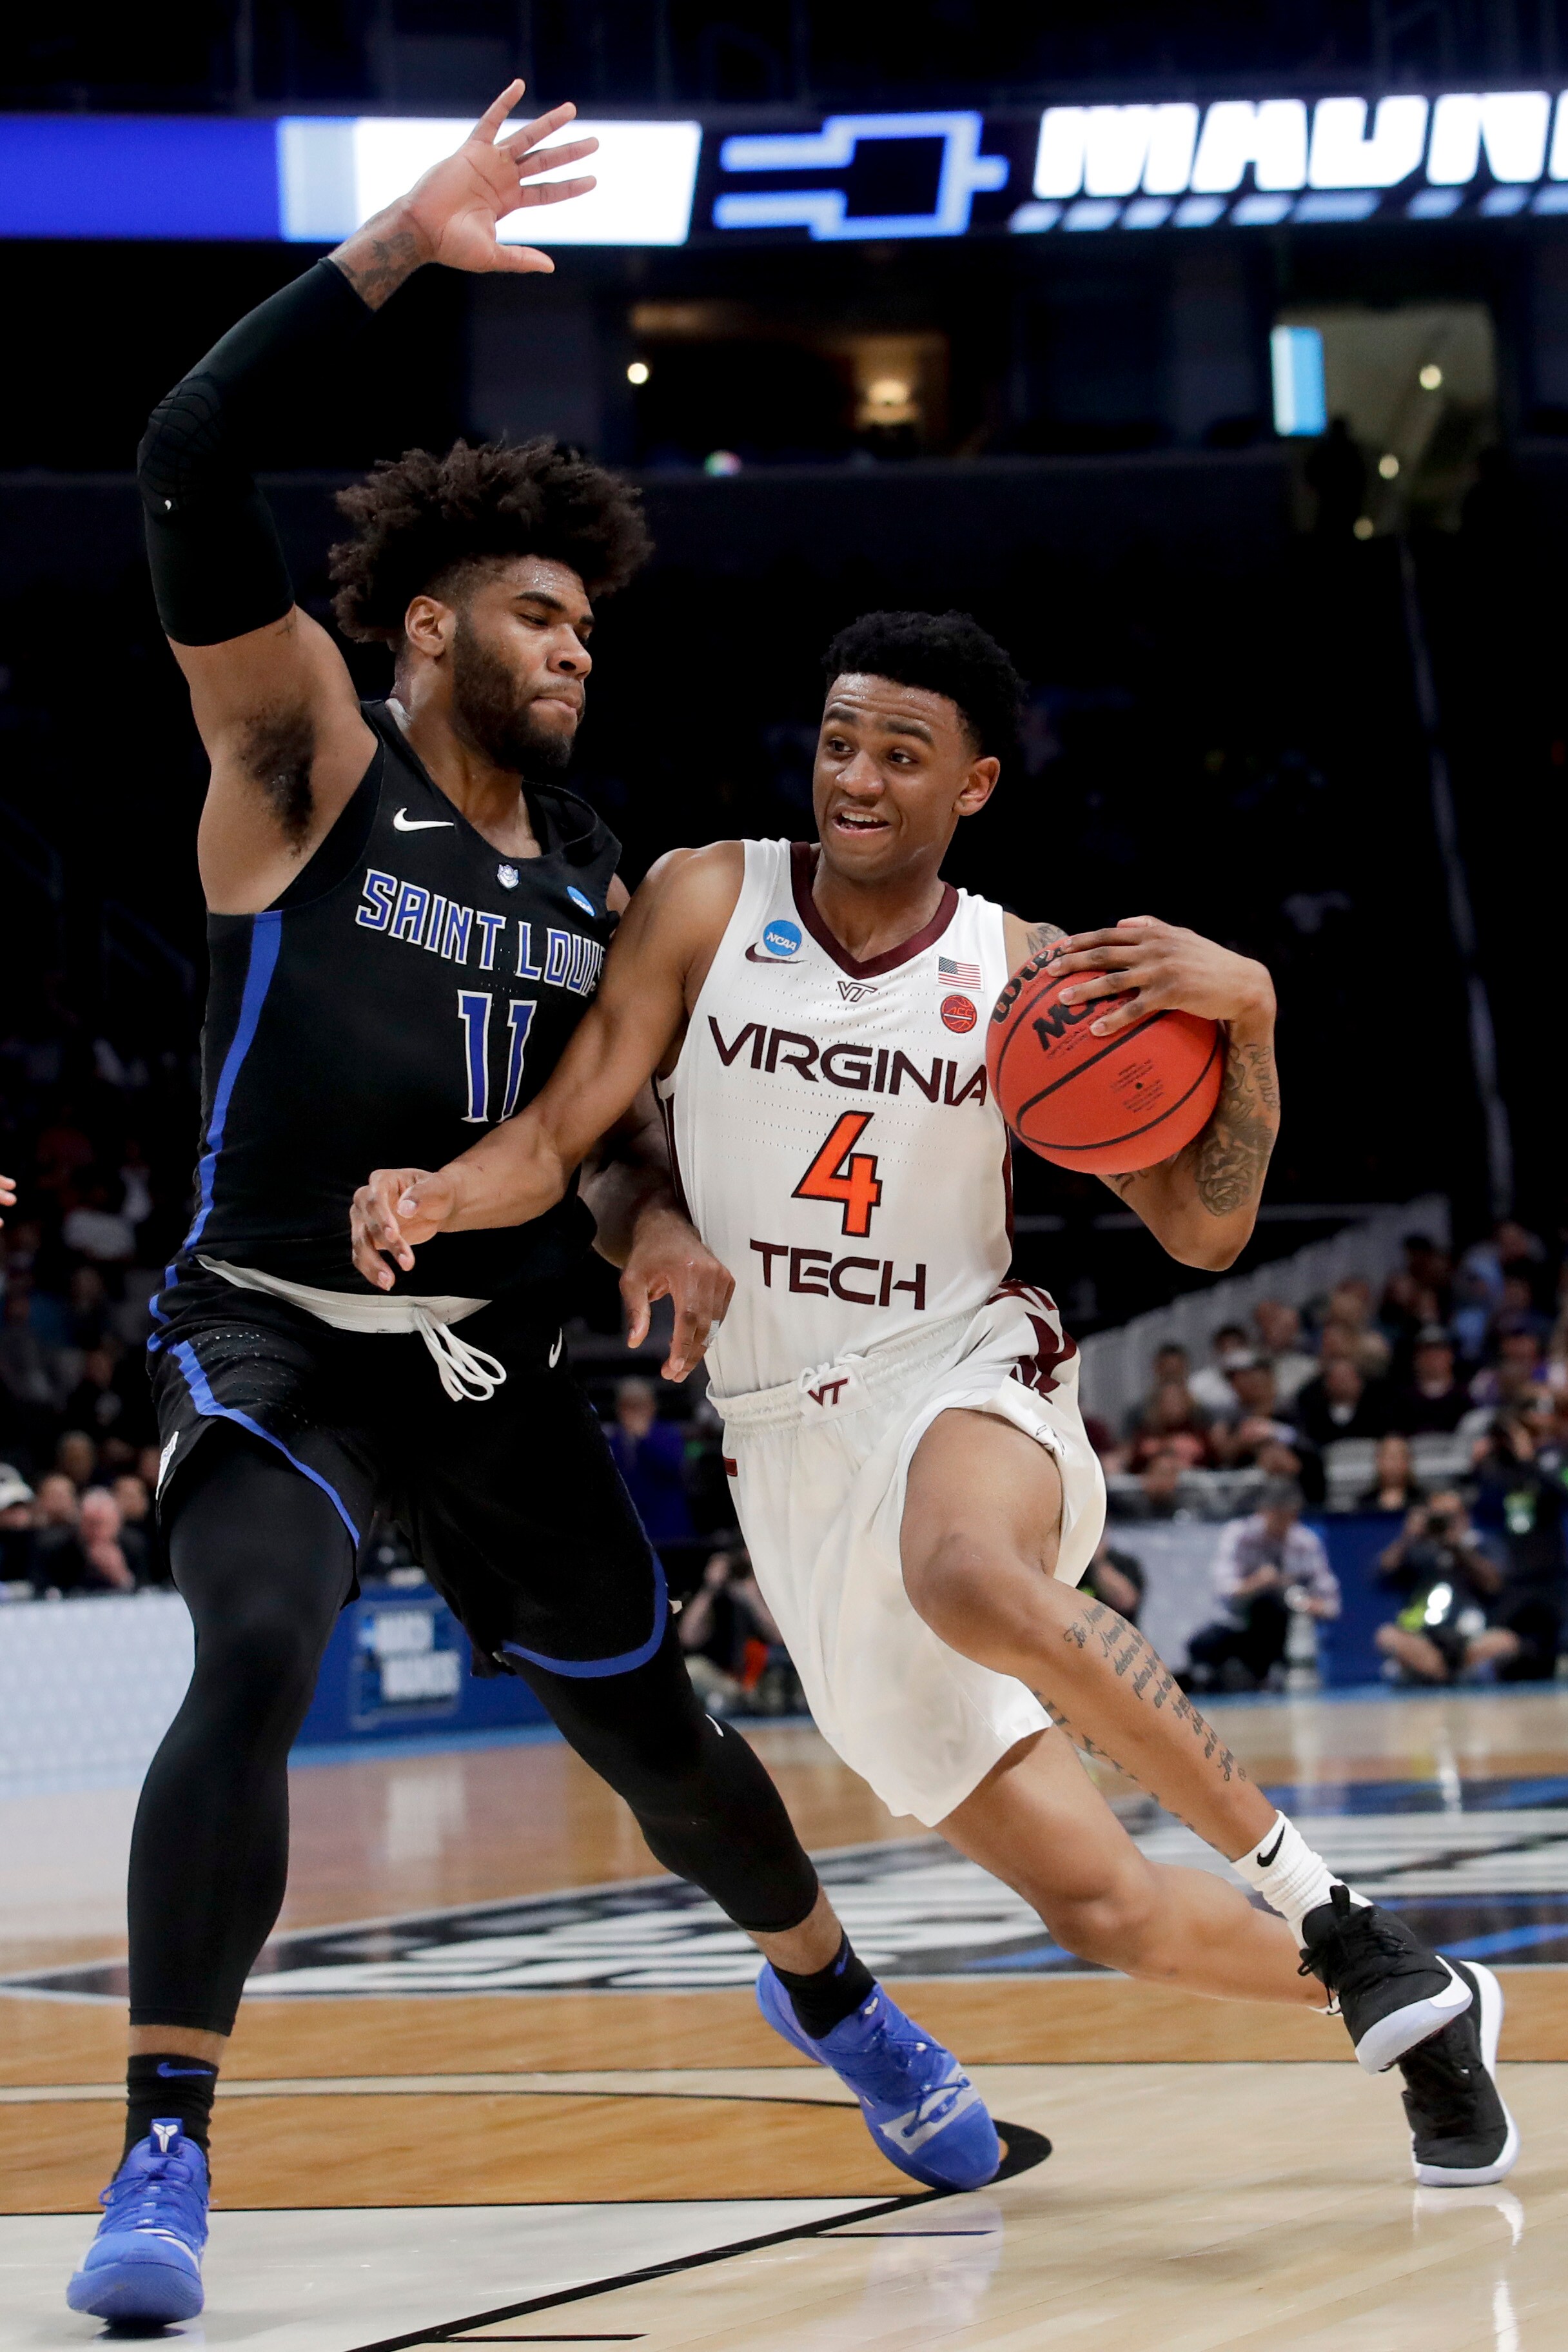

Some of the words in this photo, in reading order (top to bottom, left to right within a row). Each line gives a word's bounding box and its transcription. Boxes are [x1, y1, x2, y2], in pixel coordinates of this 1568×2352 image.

[355, 868, 507, 970] SAINT
[767, 932, 798, 951] NCAA
[838, 981, 877, 1002] VT
[457, 989, 537, 1123] 11
[708, 1015, 988, 1106] VIRGINIA
[790, 1110, 883, 1238] 4
[749, 1238, 926, 1311] TECH
[807, 1375, 850, 1407] VT
